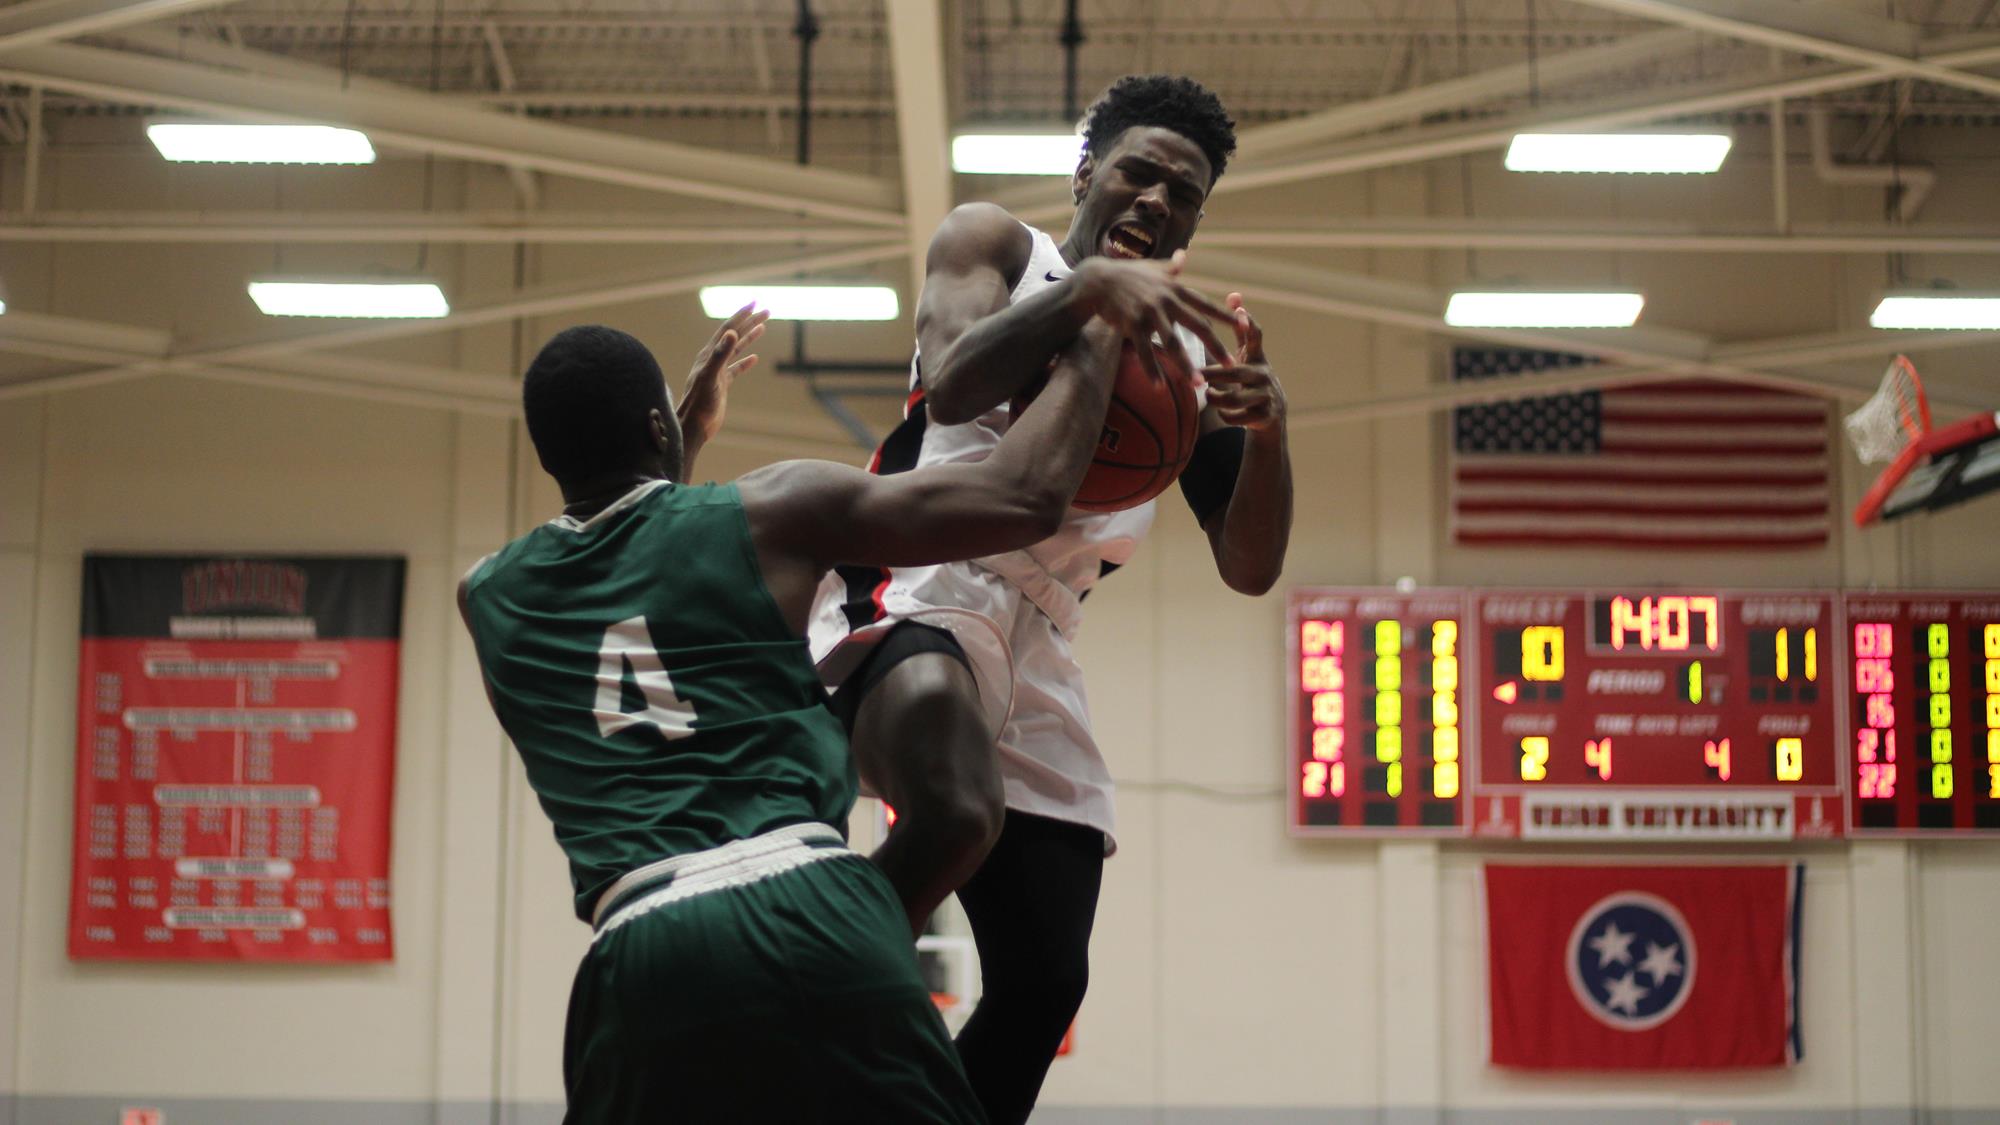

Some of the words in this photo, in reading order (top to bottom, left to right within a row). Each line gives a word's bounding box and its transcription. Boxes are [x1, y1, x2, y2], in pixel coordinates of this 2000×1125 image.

[1610, 595, 1718, 650] 14:07
[1928, 624, 1949, 658] 0
[1521, 626, 1564, 681] 0
[1776, 627, 1817, 682] 11
[592, 615, 698, 741] 4
[1689, 660, 1702, 704] 1
[1929, 659, 1950, 693] 0
[1930, 694, 1951, 728] 0
[1520, 736, 1549, 781] 2
[1584, 737, 1612, 781] 4
[1704, 738, 1731, 781] 4
[1776, 737, 1802, 781] 0
[1858, 728, 1896, 763] 21
[1931, 729, 1952, 763] 0
[1302, 761, 1344, 797] 21
[1386, 762, 1402, 797] 1
[1859, 764, 1897, 798] 22
[1932, 764, 1953, 798] 0
